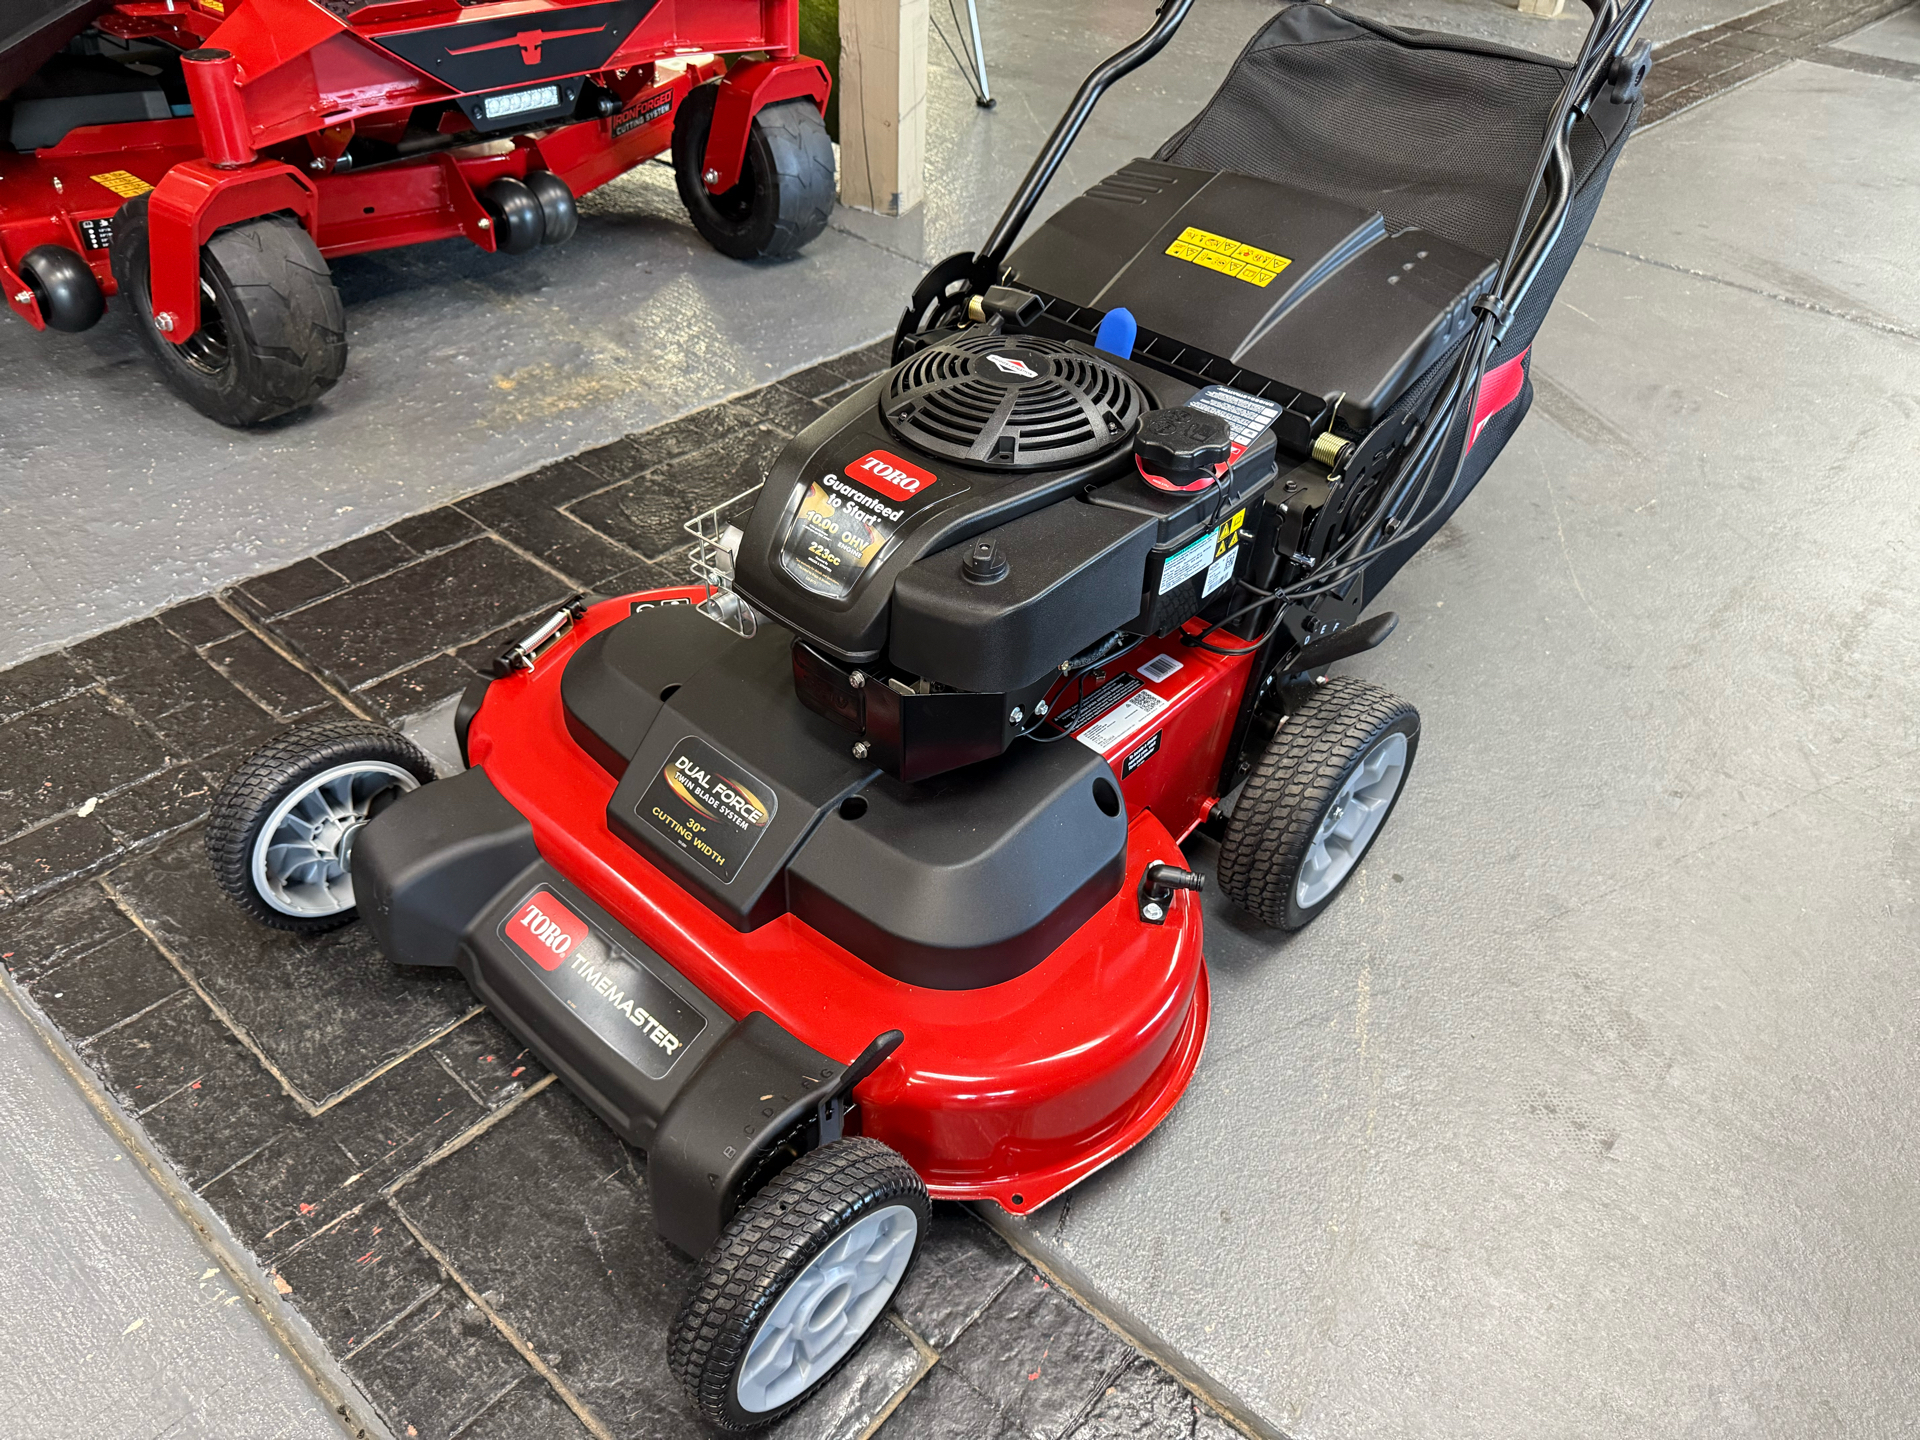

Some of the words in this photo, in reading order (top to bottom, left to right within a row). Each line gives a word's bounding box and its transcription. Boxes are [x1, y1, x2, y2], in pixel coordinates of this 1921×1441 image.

[616, 115, 645, 135] CUTTING
[645, 104, 670, 121] SYSTEM
[823, 474, 904, 522] Guaranteed
[827, 493, 841, 508] to
[807, 510, 839, 534] 10.00
[808, 541, 841, 566] 223cc
[838, 542, 863, 559] ENGINE
[841, 531, 869, 551] OHV
[674, 756, 712, 788] DUAL
[712, 783, 764, 823] FORCE
[674, 772, 694, 791] TWIN
[694, 788, 719, 809] BLADE
[719, 805, 749, 831] SYSTEM
[652, 807, 692, 841] CUTTING
[693, 837, 726, 866] WIDTH
[707, 1172, 719, 1189] A
[722, 1145, 736, 1160] B
[743, 1124, 755, 1135] C
[761, 1107, 774, 1118] D
[820, 1068, 833, 1079] G
